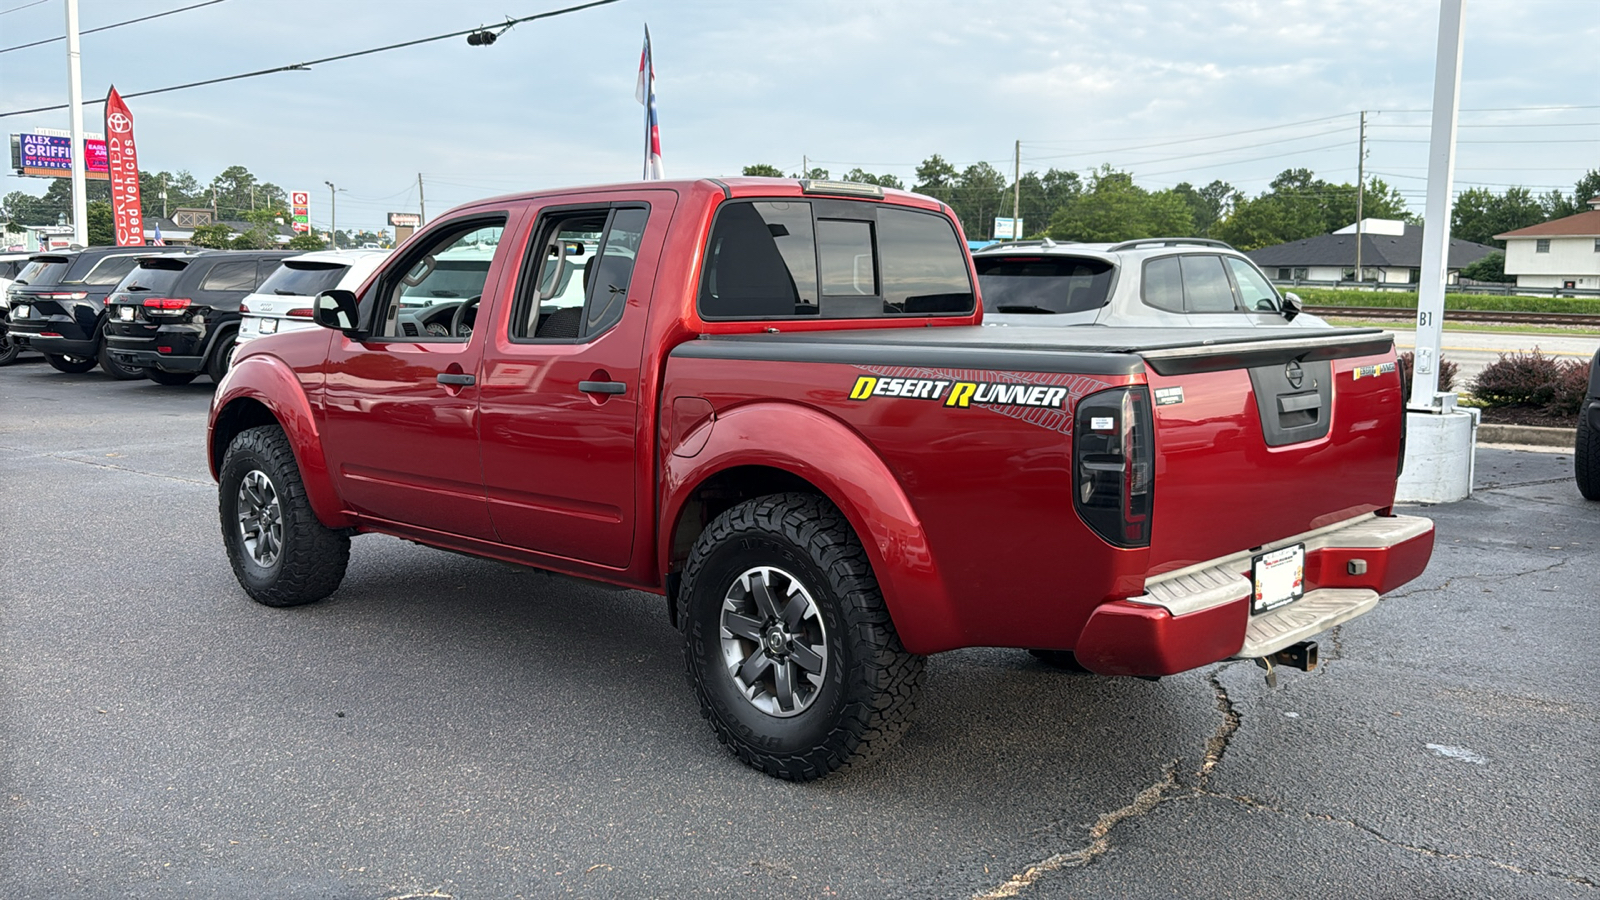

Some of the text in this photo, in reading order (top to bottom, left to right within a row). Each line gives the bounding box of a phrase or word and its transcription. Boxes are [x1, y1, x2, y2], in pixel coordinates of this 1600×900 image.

[25, 135, 51, 145] ALEX
[25, 144, 71, 158] GRIFFI
[123, 139, 141, 244] Used Vehicles
[1419, 311, 1432, 326] B1
[850, 377, 1067, 407] DESERT RUNNER
